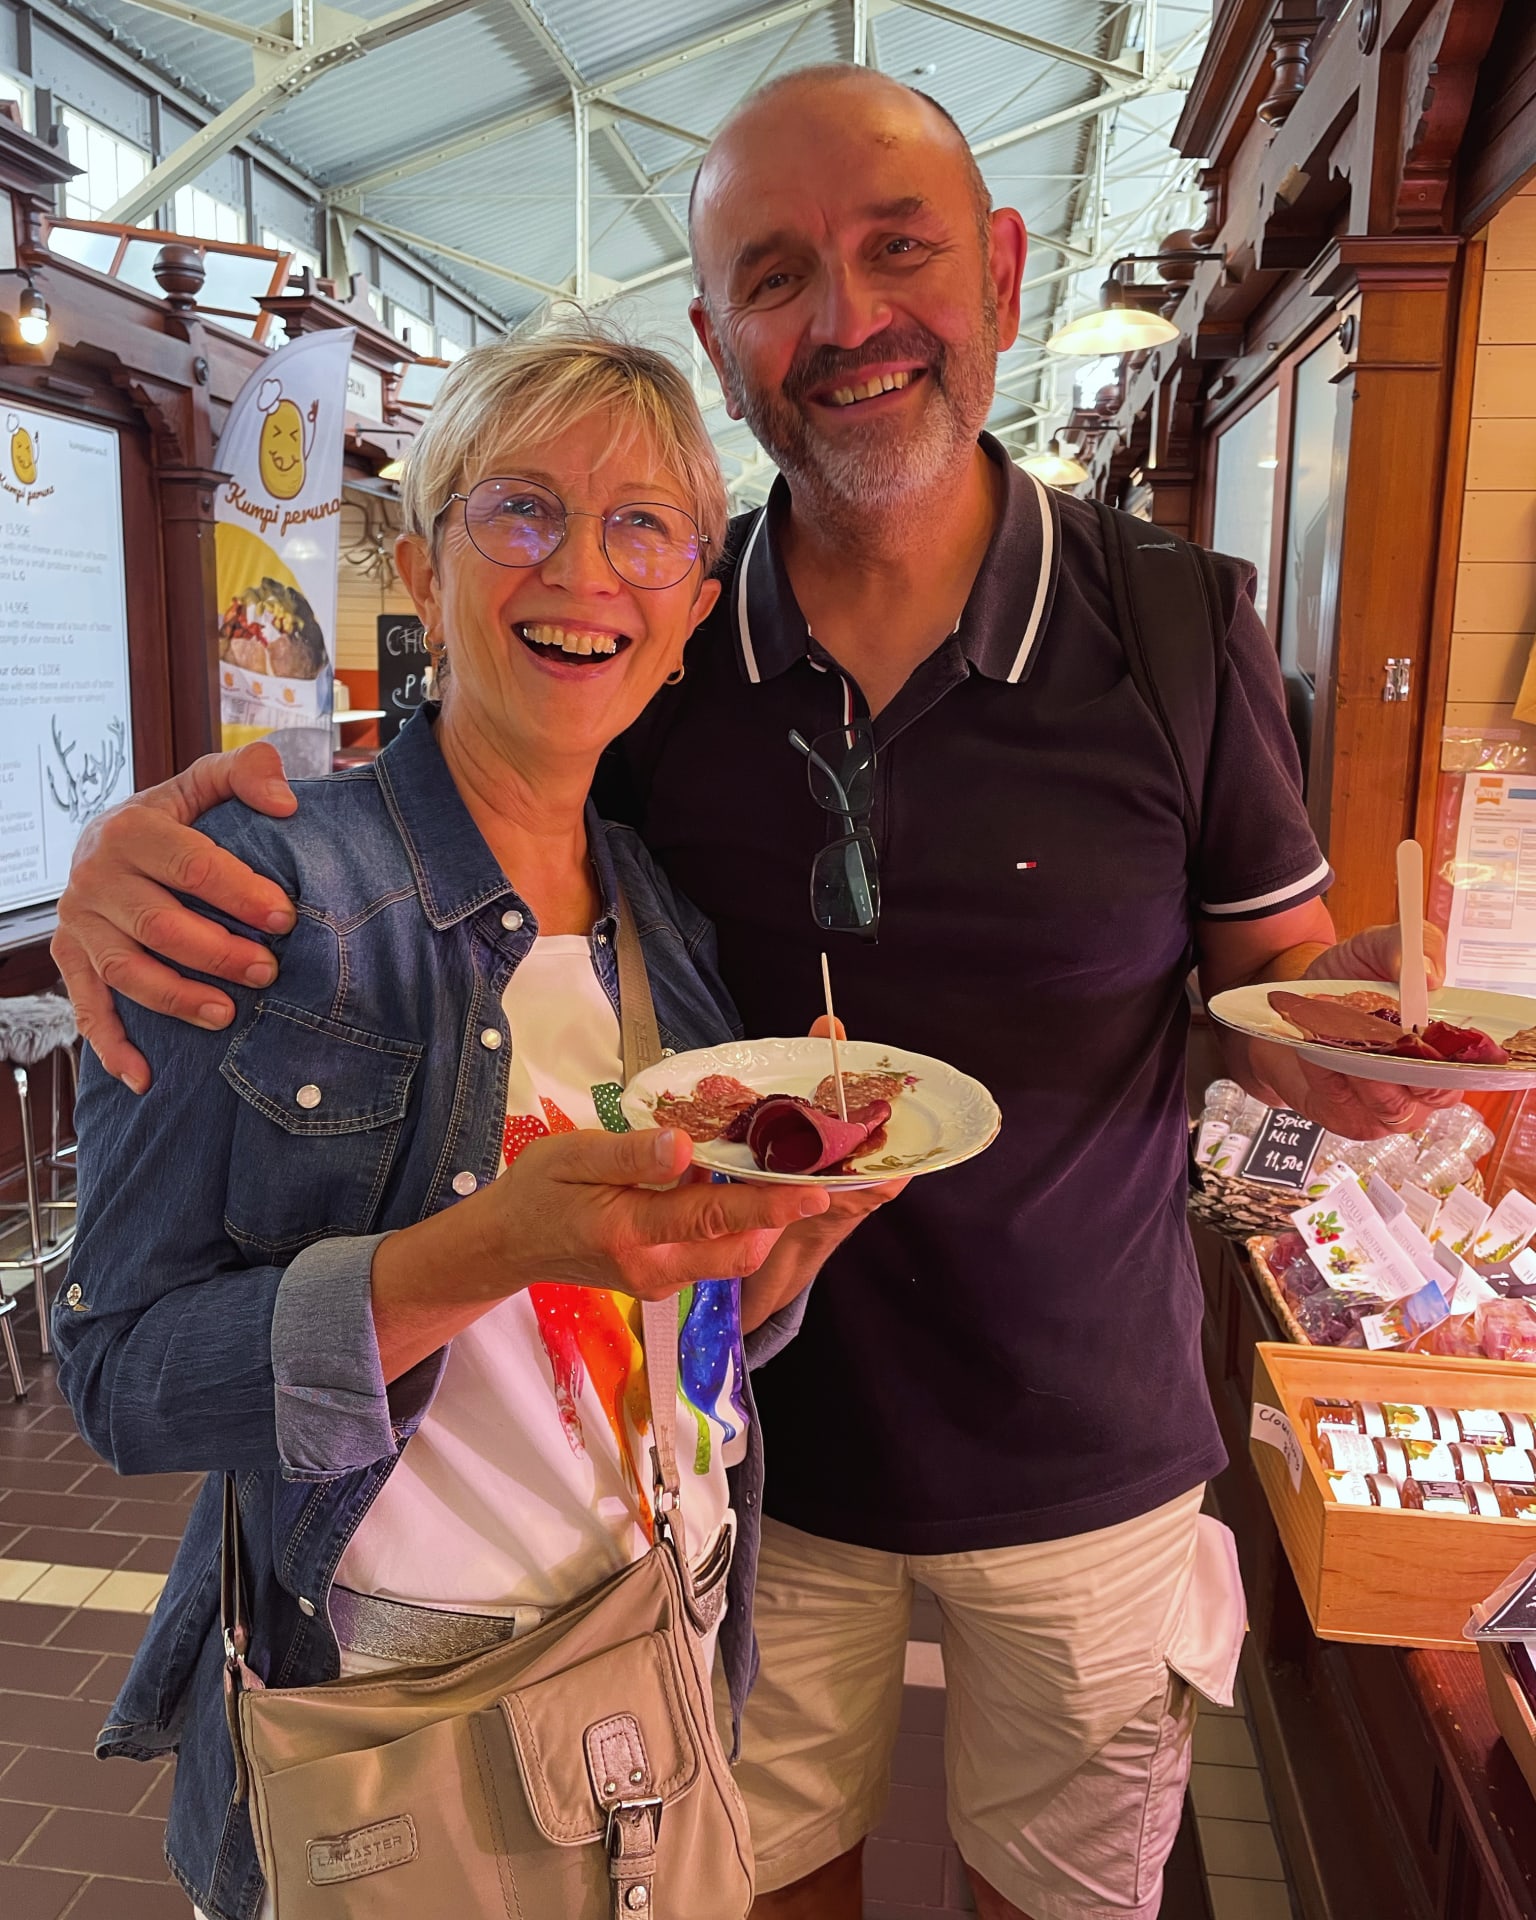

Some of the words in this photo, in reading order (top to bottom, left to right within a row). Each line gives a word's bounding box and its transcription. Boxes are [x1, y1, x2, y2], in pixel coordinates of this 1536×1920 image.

[27, 485, 54, 506] peruna
[225, 482, 279, 533] Kumpi
[281, 498, 341, 537] peruna
[1273, 1113, 1314, 1131] Spice
[1268, 1129, 1301, 1147] Mill
[318, 1835, 402, 1868] LANCASTER
